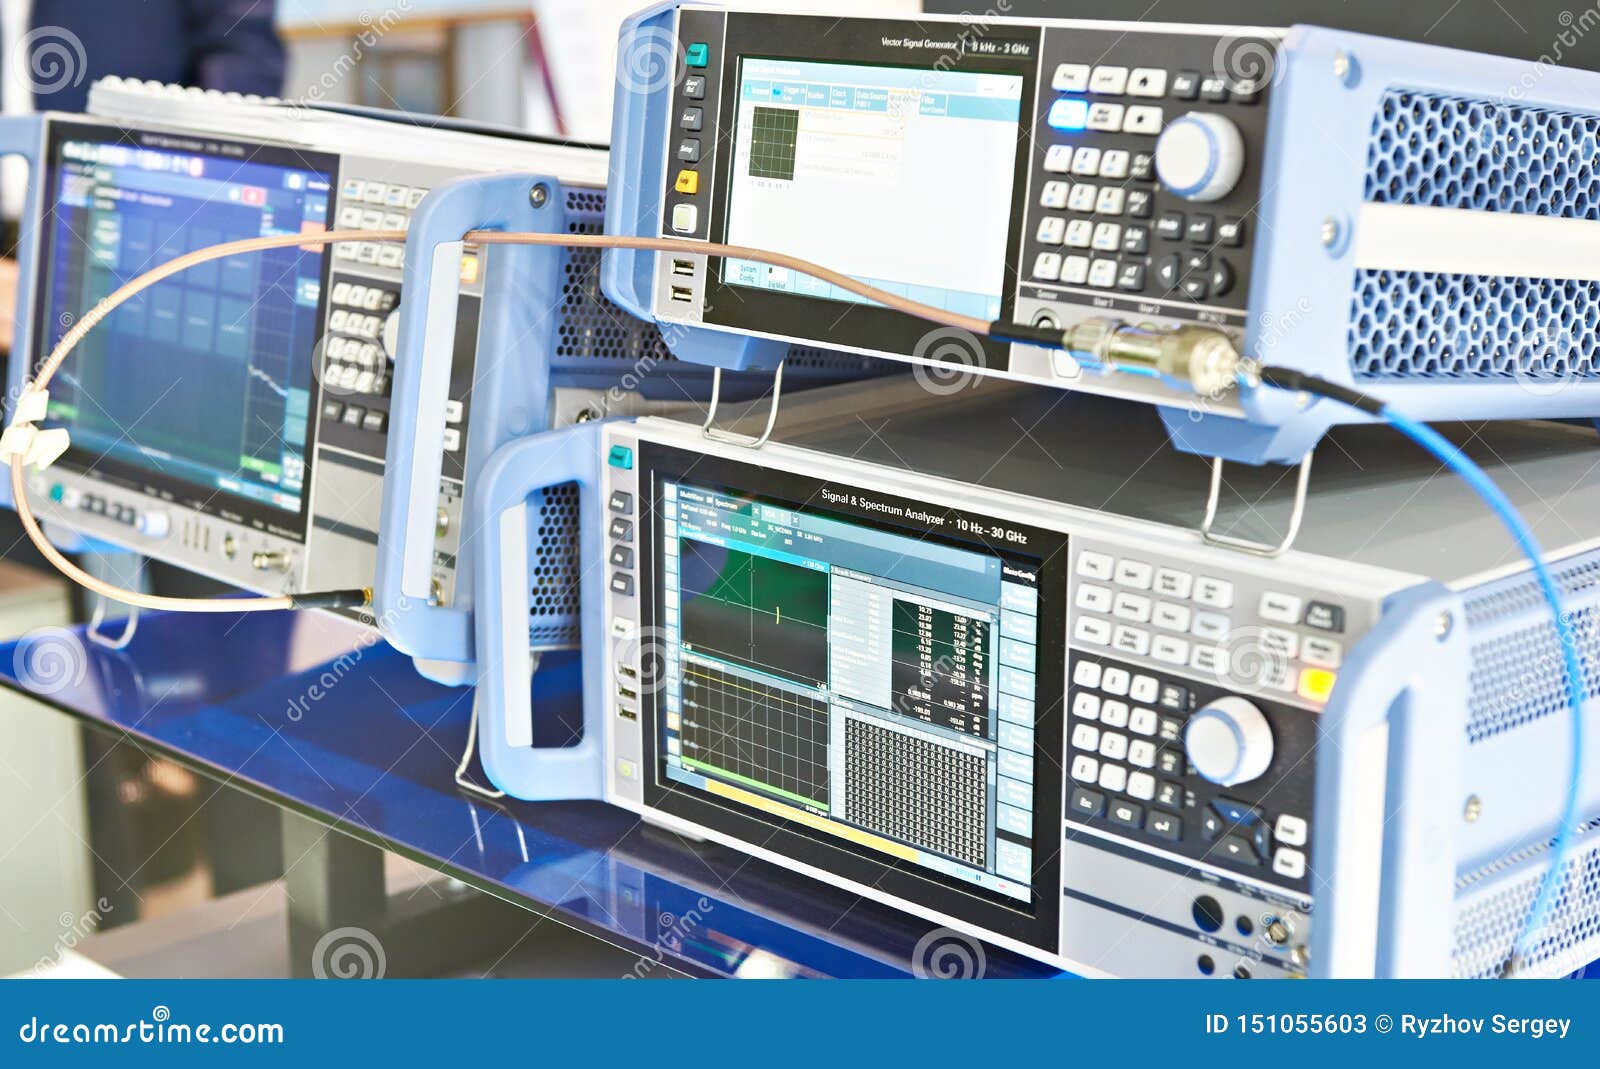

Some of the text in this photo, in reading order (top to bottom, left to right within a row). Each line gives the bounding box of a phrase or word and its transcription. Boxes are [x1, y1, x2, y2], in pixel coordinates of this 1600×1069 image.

[881, 37, 902, 47] Vector
[903, 38, 923, 49] Signal
[924, 40, 957, 50] Generator
[979, 42, 996, 53] kHz
[1003, 43, 1010, 54] 3
[1011, 43, 1030, 55] GHz
[715, 498, 738, 510] Spectrum
[821, 489, 848, 504] Signal
[850, 495, 858, 506] &
[859, 497, 902, 517] Spectrum
[904, 507, 945, 526] Analyzer
[956, 519, 969, 531] 10
[1005, 529, 1028, 545] GHz
